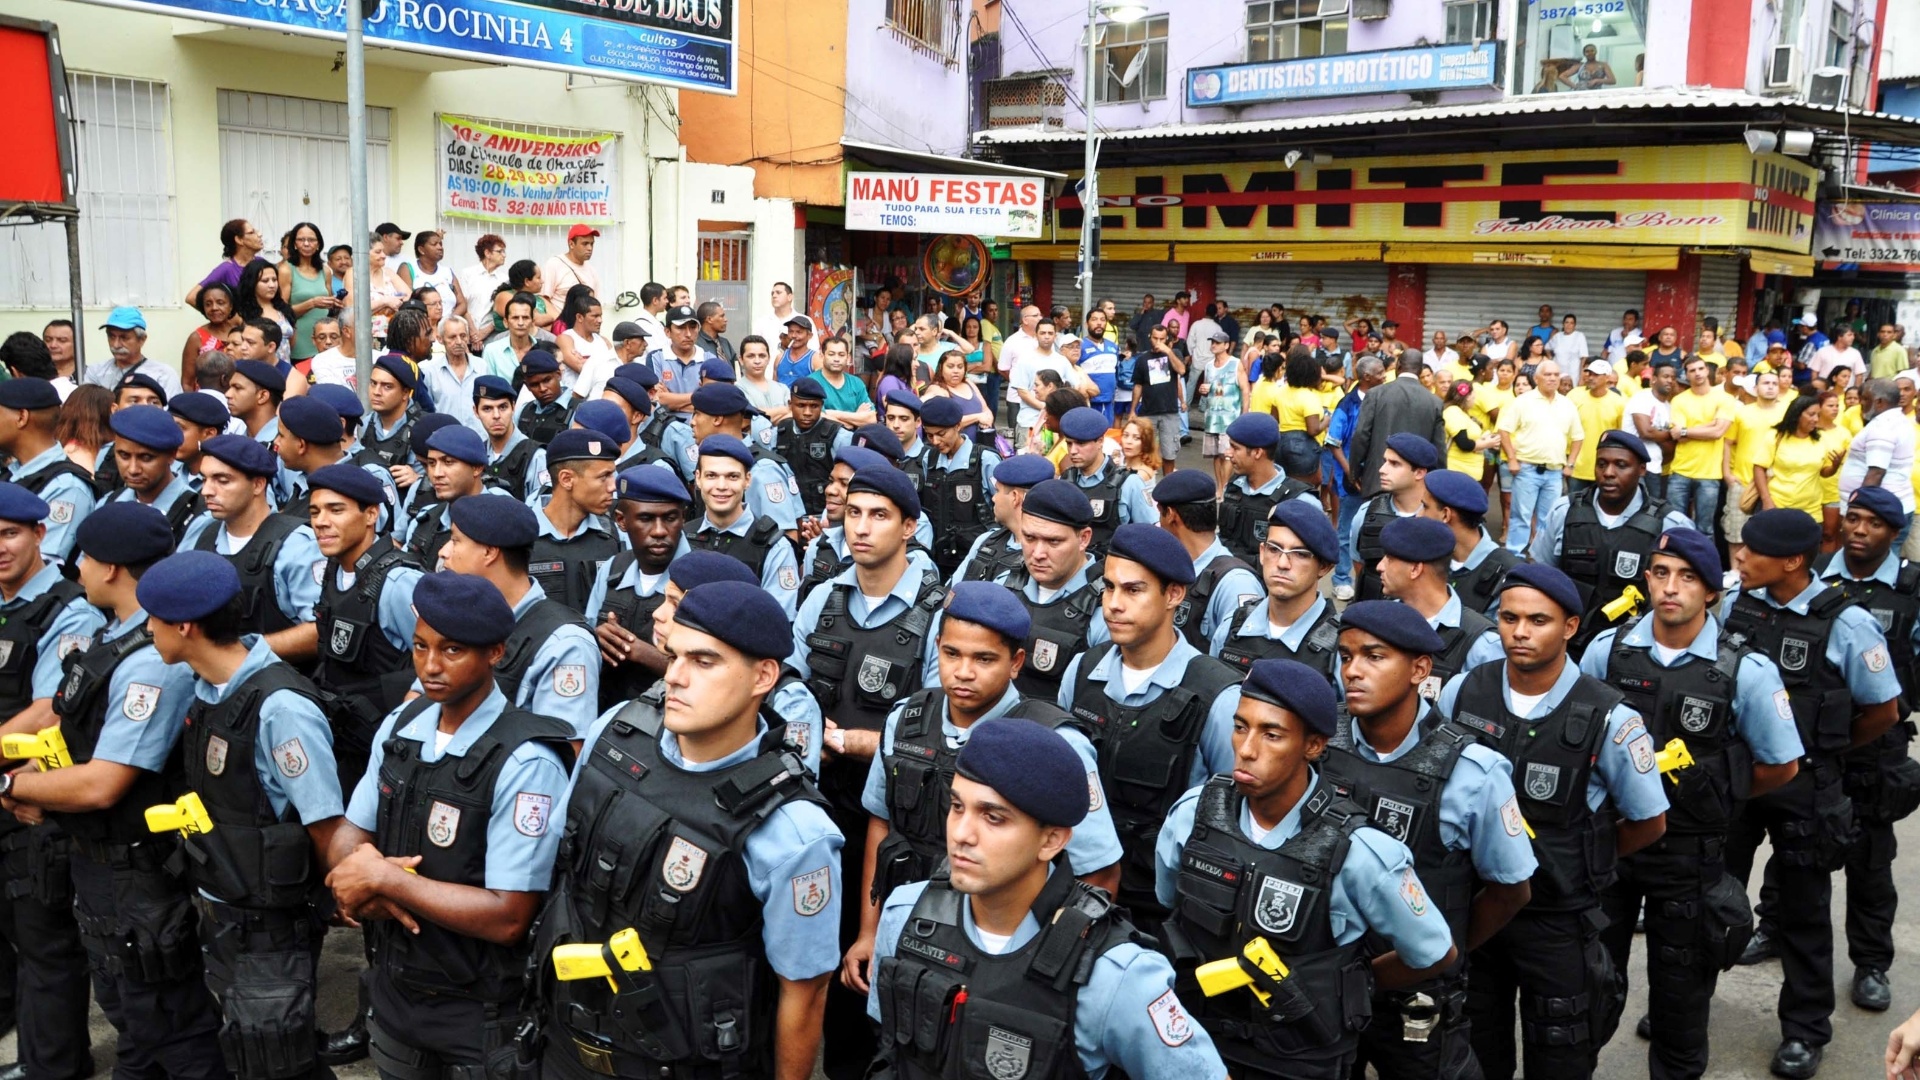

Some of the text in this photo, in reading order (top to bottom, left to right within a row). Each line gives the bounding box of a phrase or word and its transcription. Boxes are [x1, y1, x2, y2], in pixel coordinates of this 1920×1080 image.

[656, 0, 722, 30] DEUS
[1540, 1, 1624, 20] 3874-5302
[397, 0, 553, 50] ROCINHA
[559, 28, 573, 53] 4
[640, 32, 677, 47] cultos
[590, 55, 617, 65] CULTOS
[627, 61, 656, 70] ORAÇÃO
[607, 50, 634, 59] ESCOLA
[1228, 63, 1316, 93] DENTISTAS
[1319, 61, 1329, 83] E
[1332, 52, 1432, 85] PROTÉTICO
[484, 133, 602, 157] ANIVERSÁRIO
[449, 157, 479, 175] DIAS:
[528, 175, 535, 183] e
[536, 172, 557, 184] 30
[563, 170, 575, 184] de
[527, 156, 542, 170] de
[463, 177, 500, 196] 19:00
[503, 183, 519, 197] hs.
[522, 185, 551, 199] Venha
[553, 185, 609, 202] Participar!
[853, 177, 1037, 206] MANÚ FESTAS
[1754, 186, 1769, 201] NO
[451, 191, 479, 210] tema:
[547, 199, 567, 215] NÃO
[1098, 195, 1182, 206] NO
[885, 203, 1001, 215] TUDO PARA SUA FESTA
[1870, 209, 1911, 220] Clínica
[880, 214, 917, 226] TEMOS:
[1474, 211, 1722, 234] Fashion Bom
[1255, 252, 1288, 260] LIMITE
[1845, 248, 1866, 259] Tel:
[607, 748, 623, 762] REIS
[520, 796, 551, 804] PMERJ
[1381, 799, 1412, 814] PMERJ
[796, 868, 828, 885] PMERJ
[1195, 860, 1223, 877] MACEDO
[1265, 878, 1302, 896] PMERJ
[902, 936, 946, 961] GALANTE
